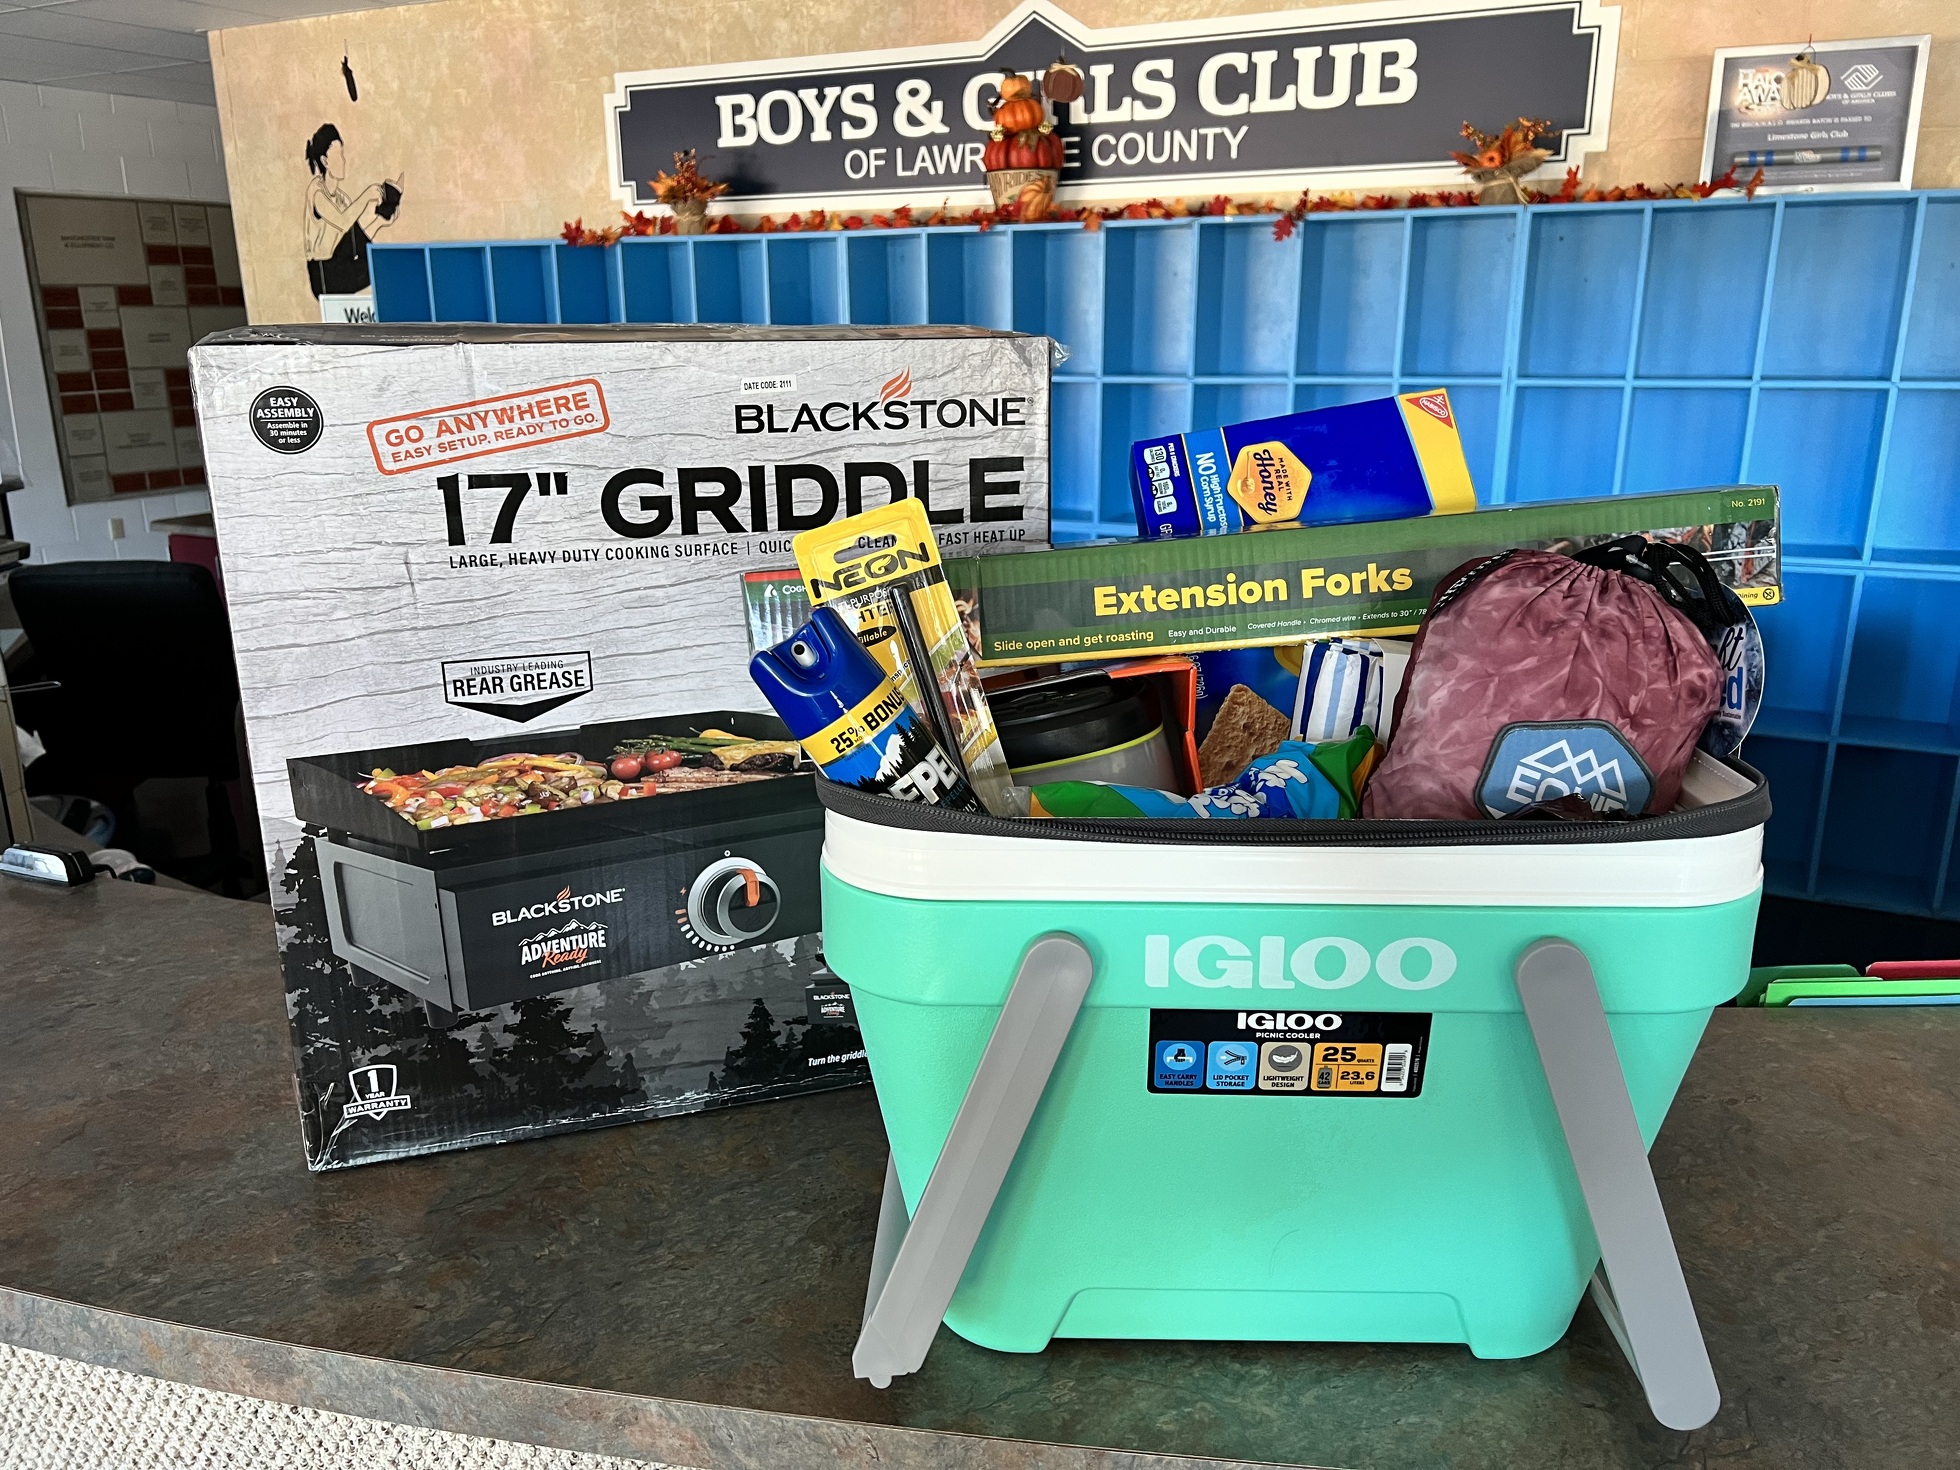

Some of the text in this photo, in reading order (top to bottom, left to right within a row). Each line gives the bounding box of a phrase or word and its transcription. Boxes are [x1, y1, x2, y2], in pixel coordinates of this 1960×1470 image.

[716, 83, 878, 148] BOYS
[892, 79, 949, 138] &
[1198, 38, 1418, 116] CLUB
[1767, 132, 1808, 142] Limestone
[1830, 129, 1849, 138] Club
[844, 125, 1249, 179] OF LAWRE COUNTY
[743, 380, 792, 391] DATE CODE: 2111
[257, 408, 314, 418] ASSEMBLY
[269, 397, 298, 407] EASY
[385, 391, 590, 447] GO ANYWHERE
[734, 396, 1026, 434] BLACKSTONE
[391, 445, 433, 463] EASY
[494, 423, 545, 441] READY
[550, 418, 570, 430] TO
[1154, 448, 1165, 461] 130
[1195, 452, 1217, 475] NO
[1210, 474, 1222, 493] High
[1253, 449, 1278, 516] Honey
[1274, 469, 1285, 492] REAL
[1278, 457, 1293, 501] MADE WITH
[436, 456, 1025, 547] 17" GRIDDLE
[1204, 497, 1217, 523] Syrup
[1731, 498, 1766, 508] No. 2191
[449, 553, 503, 569] LARGE,
[508, 550, 556, 566] HEAVY
[562, 548, 600, 563] DUTY
[605, 545, 670, 561] COOKING
[674, 542, 738, 558] SURFACE
[759, 539, 793, 554] QUIC
[938, 531, 969, 545] FAST
[974, 529, 1005, 543] HEAT
[1009, 528, 1026, 542] UP
[810, 542, 930, 599] NEON
[1093, 562, 1414, 617] Extension Forks
[994, 639, 1023, 651] Slide
[1026, 638, 1055, 651] open
[1058, 635, 1080, 647] and
[1084, 634, 1103, 647] get
[1106, 630, 1154, 644] roasting
[1168, 629, 1187, 639] Easy
[1189, 627, 1204, 636] and
[1205, 625, 1237, 635] Durable
[1247, 620, 1276, 630] Covered
[1277, 619, 1302, 627] Handle
[1309, 615, 1341, 625] Chromed
[1342, 614, 1356, 622] wire
[1362, 611, 1390, 620] Extends
[1391, 610, 1398, 618] to
[470, 660, 564, 676] INDUSTRY LEADING
[453, 669, 585, 698] REAR GREASE
[830, 725, 865, 755] 25%
[491, 889, 624, 926] BLACKSTONE
[521, 929, 607, 966] ADVENTURE
[542, 945, 588, 968] Ready
[1144, 934, 1458, 990] IGLOO
[1237, 1012, 1342, 1031] IGLOO
[1255, 1031, 1284, 1039] PICNIC
[808, 1057, 826, 1067] Turn
[827, 1054, 840, 1064] the
[1321, 1046, 1356, 1063] 25
[367, 1069, 379, 1093] 1
[1319, 1070, 1376, 1081] 42 23.6
[348, 1099, 407, 1114] WARRANTY
[365, 1091, 386, 1100] YEAR
